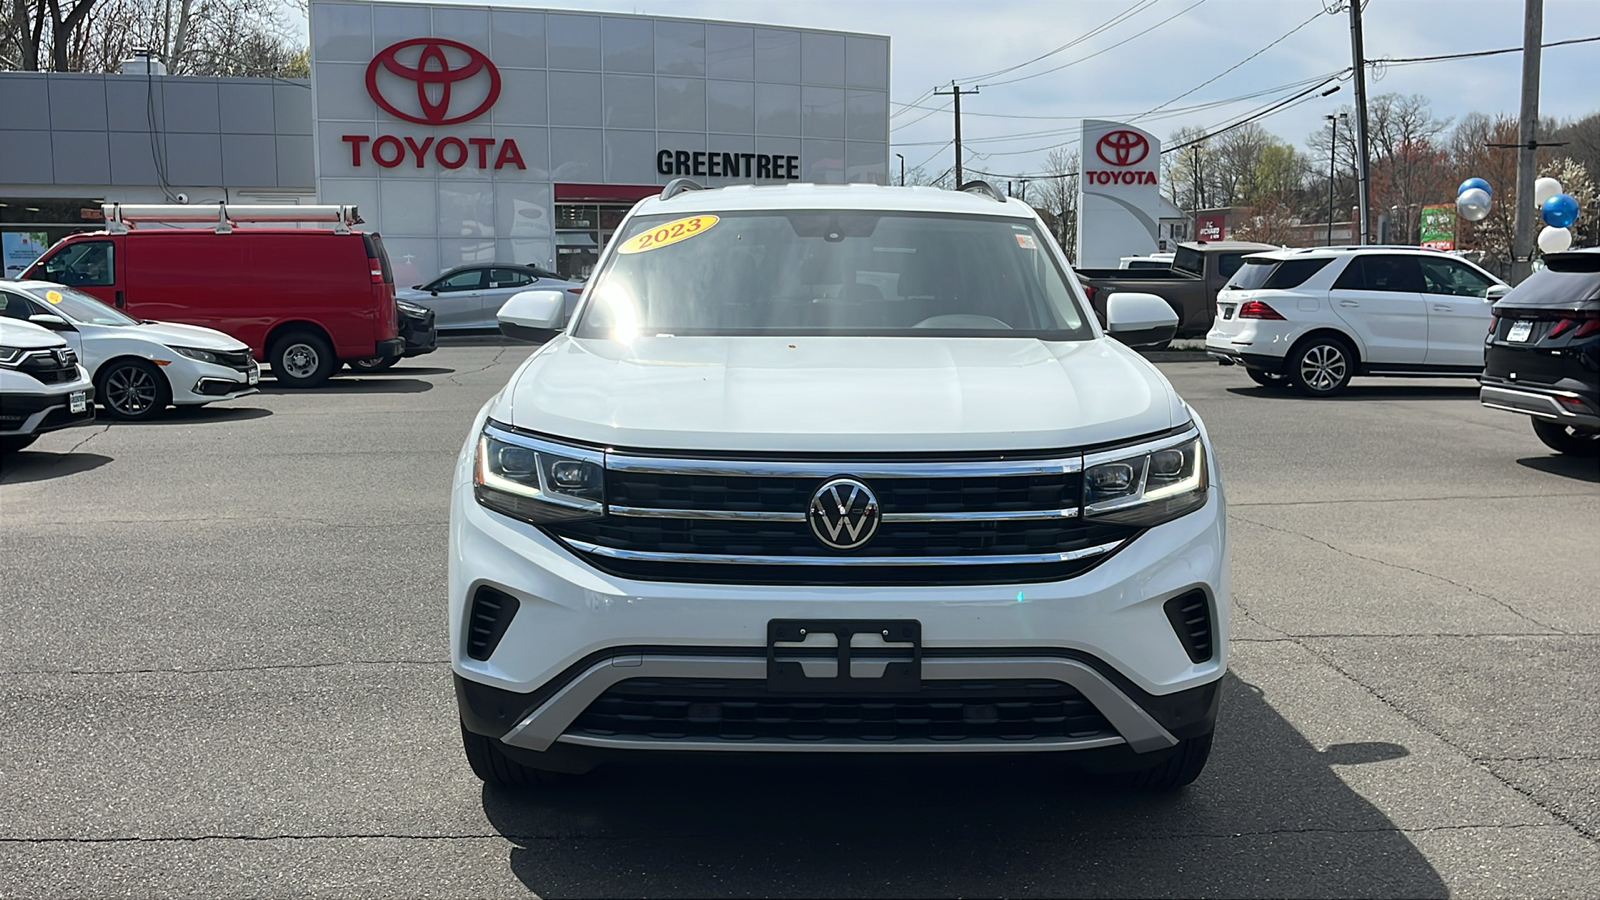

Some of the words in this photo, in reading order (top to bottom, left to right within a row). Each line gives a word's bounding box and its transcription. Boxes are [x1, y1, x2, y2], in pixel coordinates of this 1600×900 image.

[342, 135, 527, 170] TOYOTA
[657, 149, 799, 179] GREENTREE
[1086, 171, 1157, 185] TOYOTA
[638, 218, 702, 249] 2023
